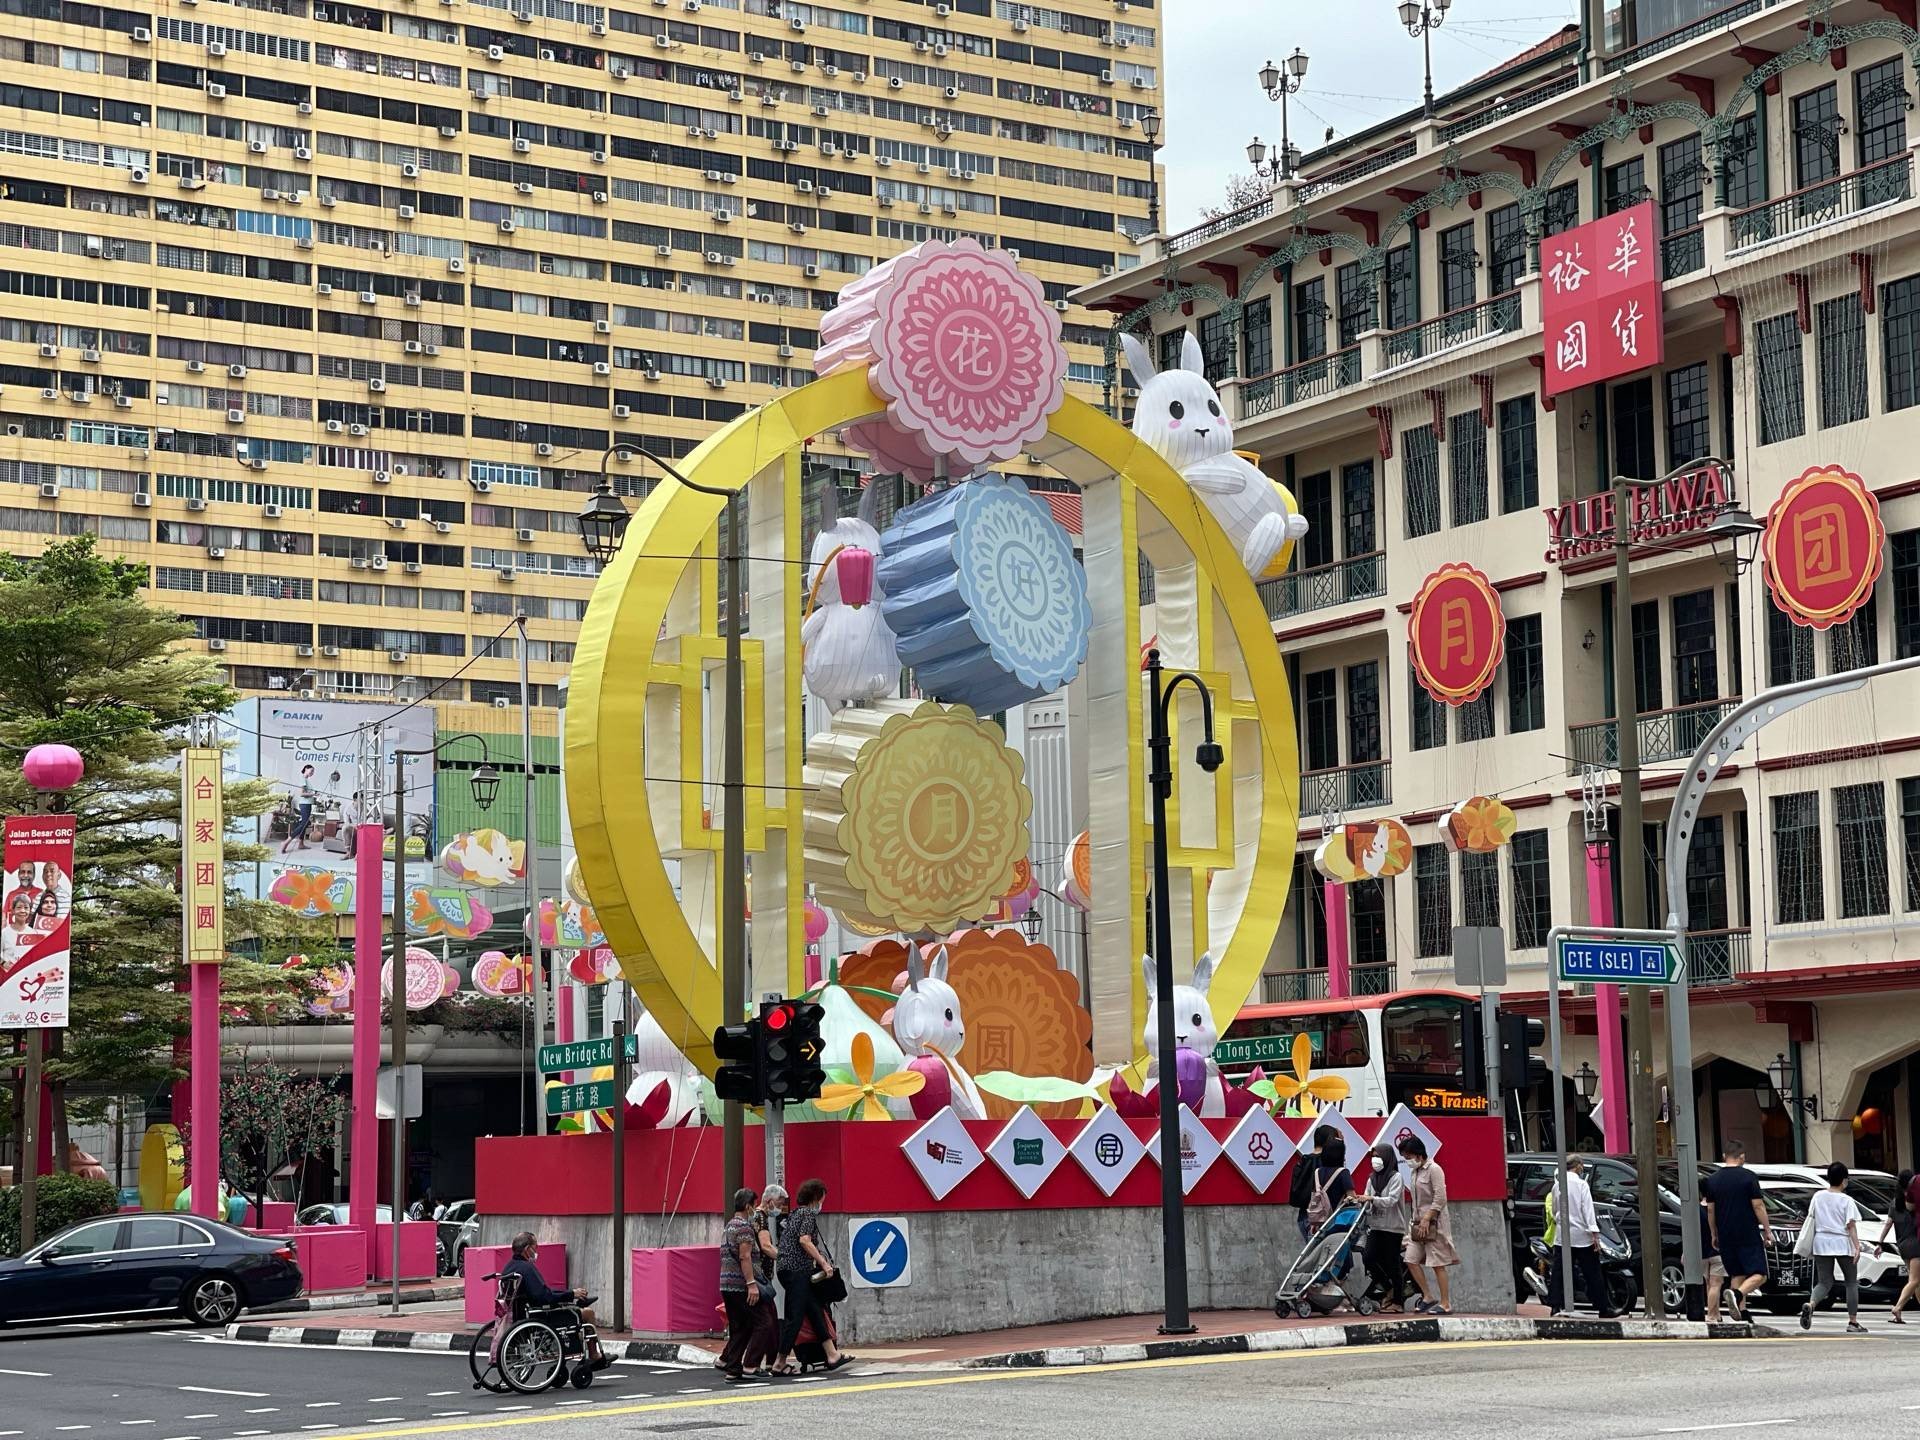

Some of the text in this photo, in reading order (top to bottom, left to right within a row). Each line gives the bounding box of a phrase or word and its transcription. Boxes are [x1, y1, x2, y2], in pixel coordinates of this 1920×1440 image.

[1549, 217, 1642, 294] 裕華
[948, 324, 993, 377] 花
[1543, 465, 1728, 545] YUE HWA
[1544, 512, 1718, 563] CHINES PRODUCT
[1793, 502, 1852, 592] 团
[1006, 553, 1040, 606] 好
[1440, 597, 1475, 671] 月
[283, 712, 324, 721] DAIKIN
[281, 736, 330, 751] ECO
[295, 751, 331, 762] Comes
[332, 752, 356, 764] First
[9, 828, 73, 838] Jalan Besar GRC
[922, 791, 958, 849] 月
[194, 775, 216, 930] 合家团圆
[1568, 950, 1634, 971] CTE (SLE)
[543, 1050, 561, 1066] New
[565, 1046, 597, 1065] Bridge
[600, 1042, 613, 1060] Rd
[1226, 1042, 1251, 1060] Tong
[1255, 1040, 1274, 1056] Sen
[1278, 1038, 1290, 1053] St
[561, 1085, 599, 1111] 新桥路
[1414, 1088, 1488, 1109] SBS Transit
